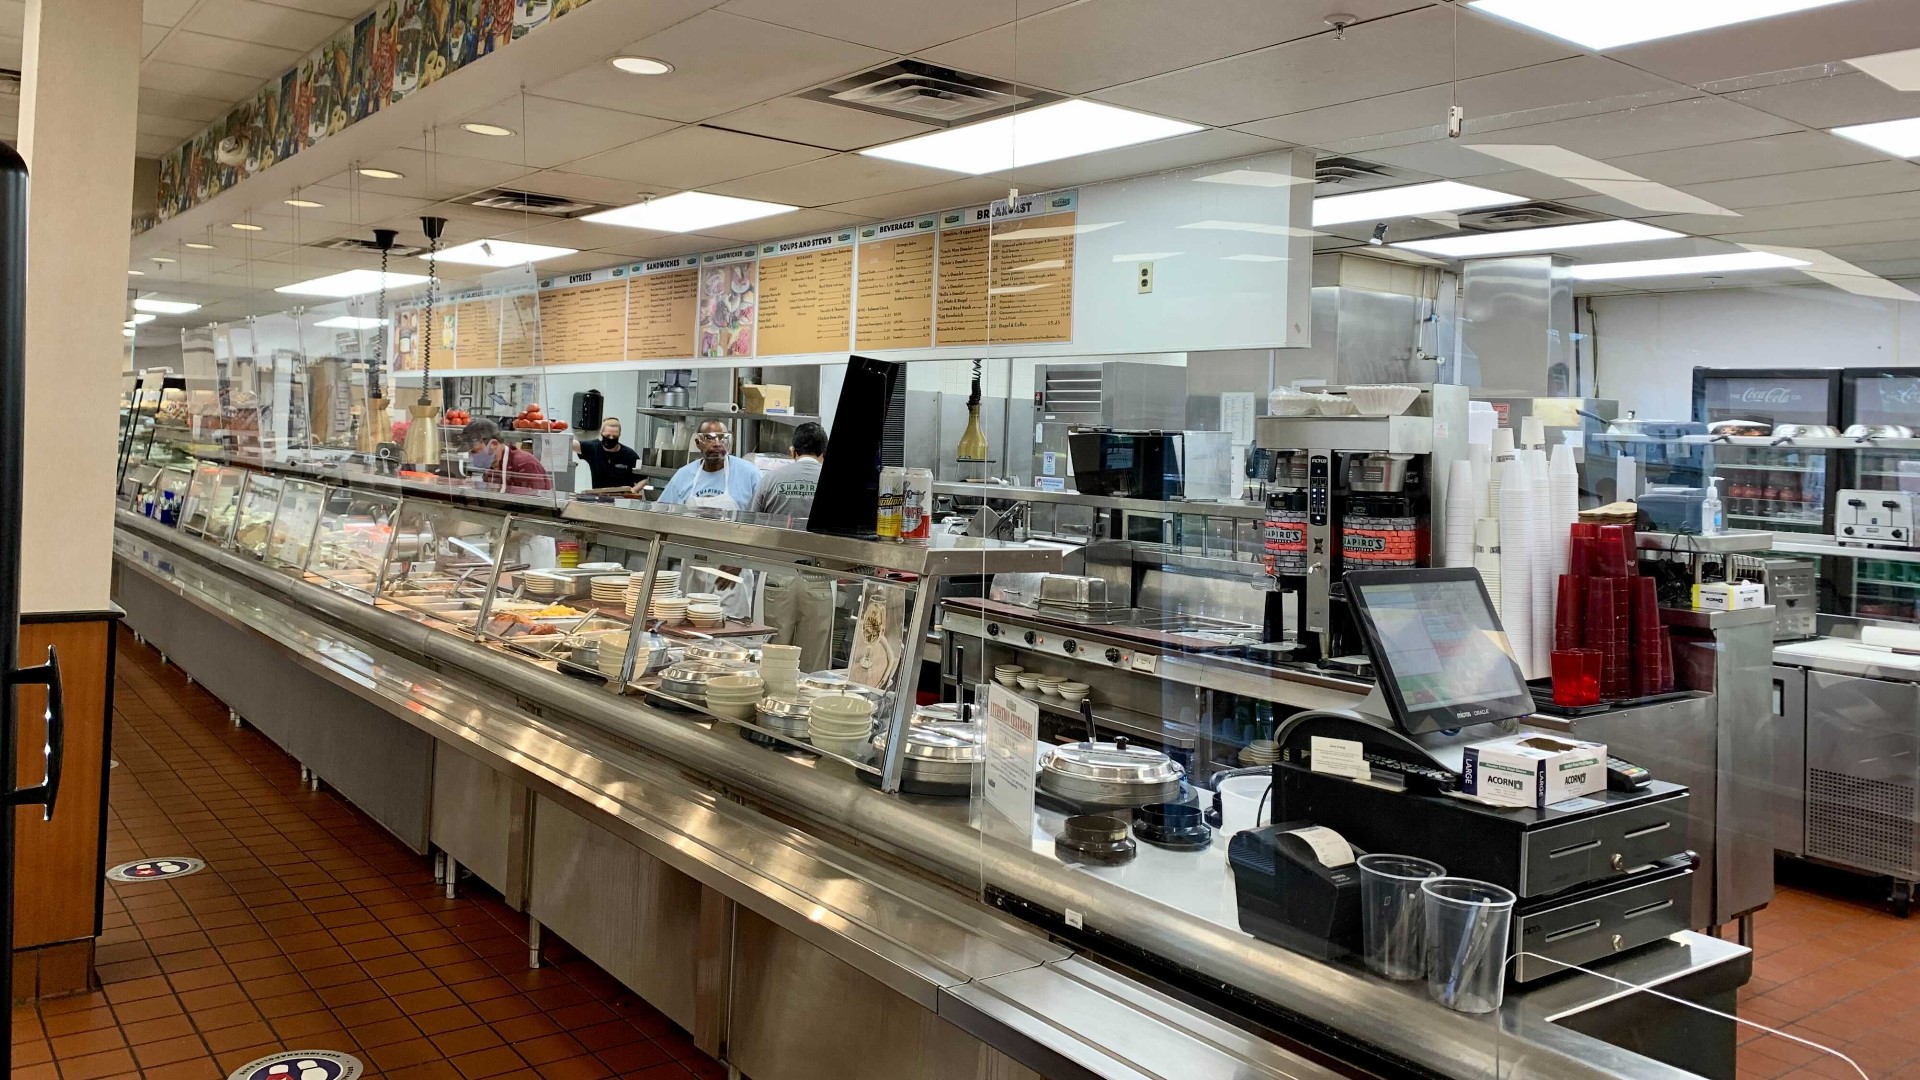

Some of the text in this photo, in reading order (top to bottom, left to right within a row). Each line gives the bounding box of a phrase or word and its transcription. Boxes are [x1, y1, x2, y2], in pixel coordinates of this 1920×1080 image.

[977, 202, 1032, 219] BRAKAST
[880, 221, 914, 233] BEVERAGES
[780, 237, 831, 251] SOUPS AND STEWS
[716, 251, 742, 259] SANDWICHES
[647, 259, 679, 270] SANDWICHES
[570, 273, 591, 283] ENTREES
[779, 484, 815, 493] SHAPIR
[1464, 758, 1473, 785] LARGE
[1487, 775, 1514, 787] ACORN
[1565, 774, 1581, 785] ACORN
